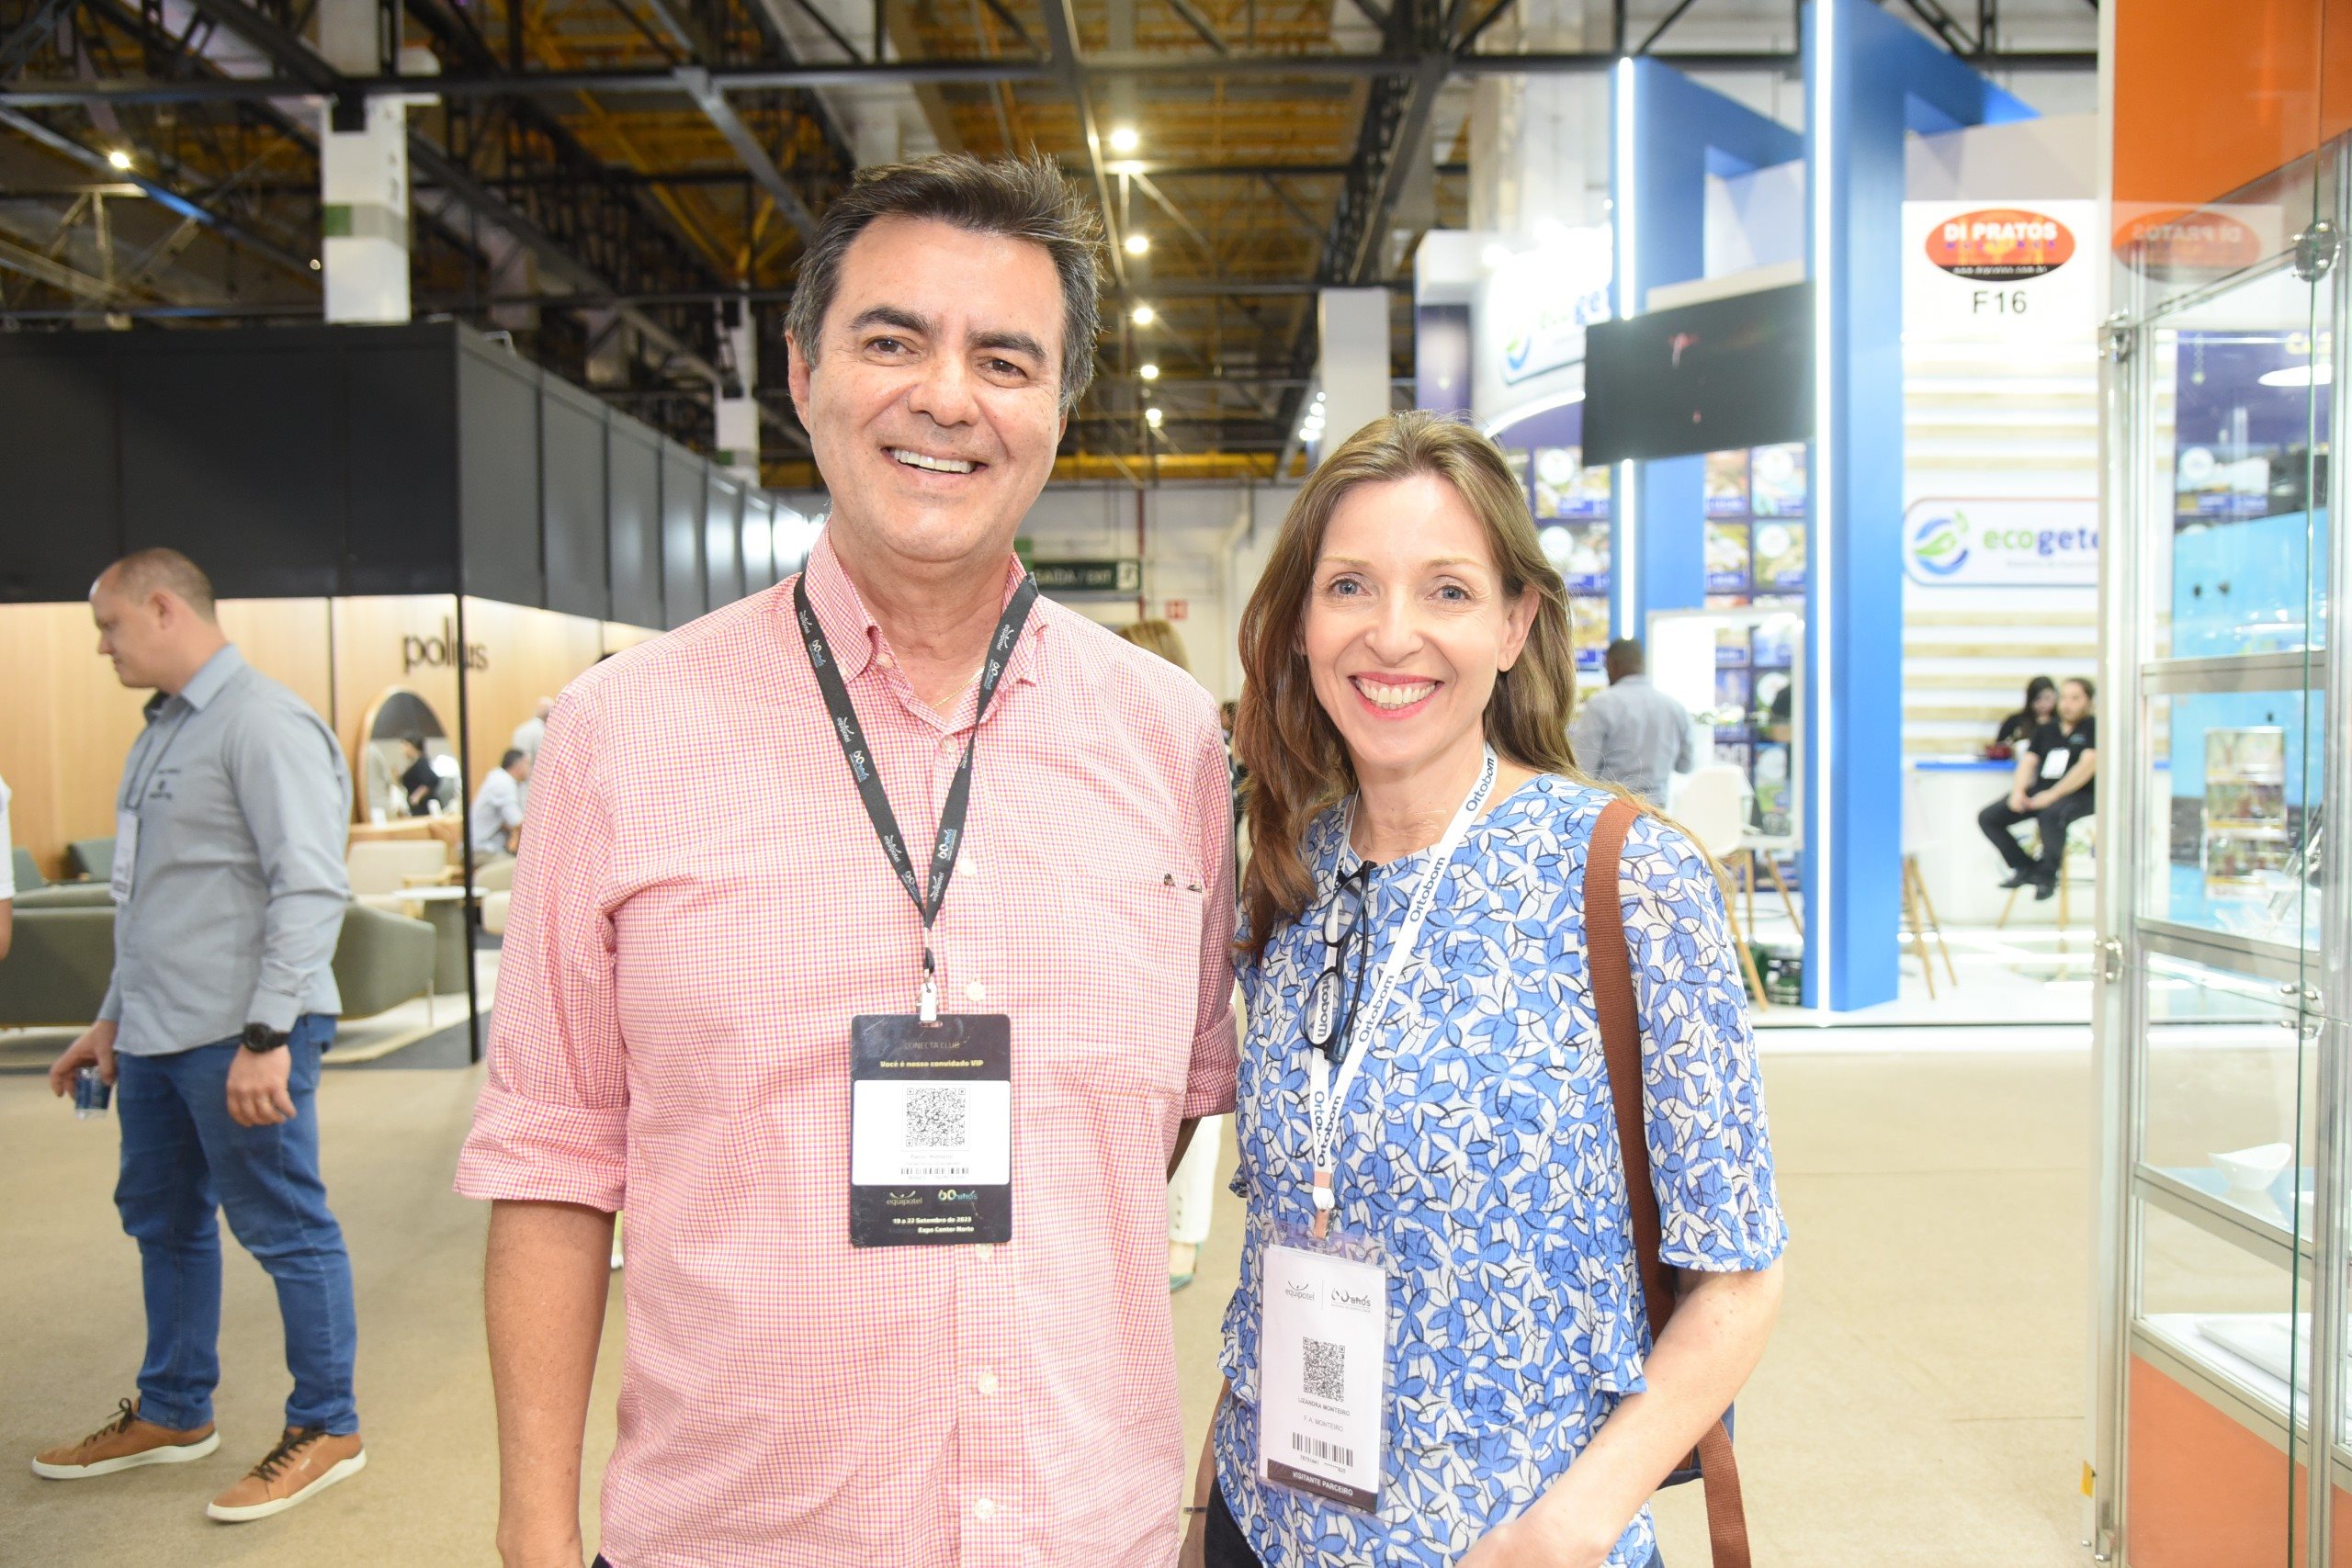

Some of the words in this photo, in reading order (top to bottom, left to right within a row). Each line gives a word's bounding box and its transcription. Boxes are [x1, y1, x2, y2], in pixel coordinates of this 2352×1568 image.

[1943, 223, 1967, 241] DI
[1973, 222, 2058, 241] PRATOS
[1973, 290, 2027, 313] F16
[1465, 757, 1495, 812] Ortobom
[1409, 857, 1445, 922] Ortobom
[1359, 975, 1395, 1043] Ortobom
[1317, 1095, 1341, 1168] Ortobom
[887, 1196, 922, 1206] equipotel
[1285, 1288, 1315, 1302] equipotel
[1297, 1396, 1322, 1408] LIZANDRA
[1323, 1404, 1351, 1416] MONTEIRO
[1315, 1418, 1343, 1432] MONTEIRO
[1293, 1470, 1321, 1486] VISITANTE
[1322, 1480, 1353, 1495] PARCEIRO
